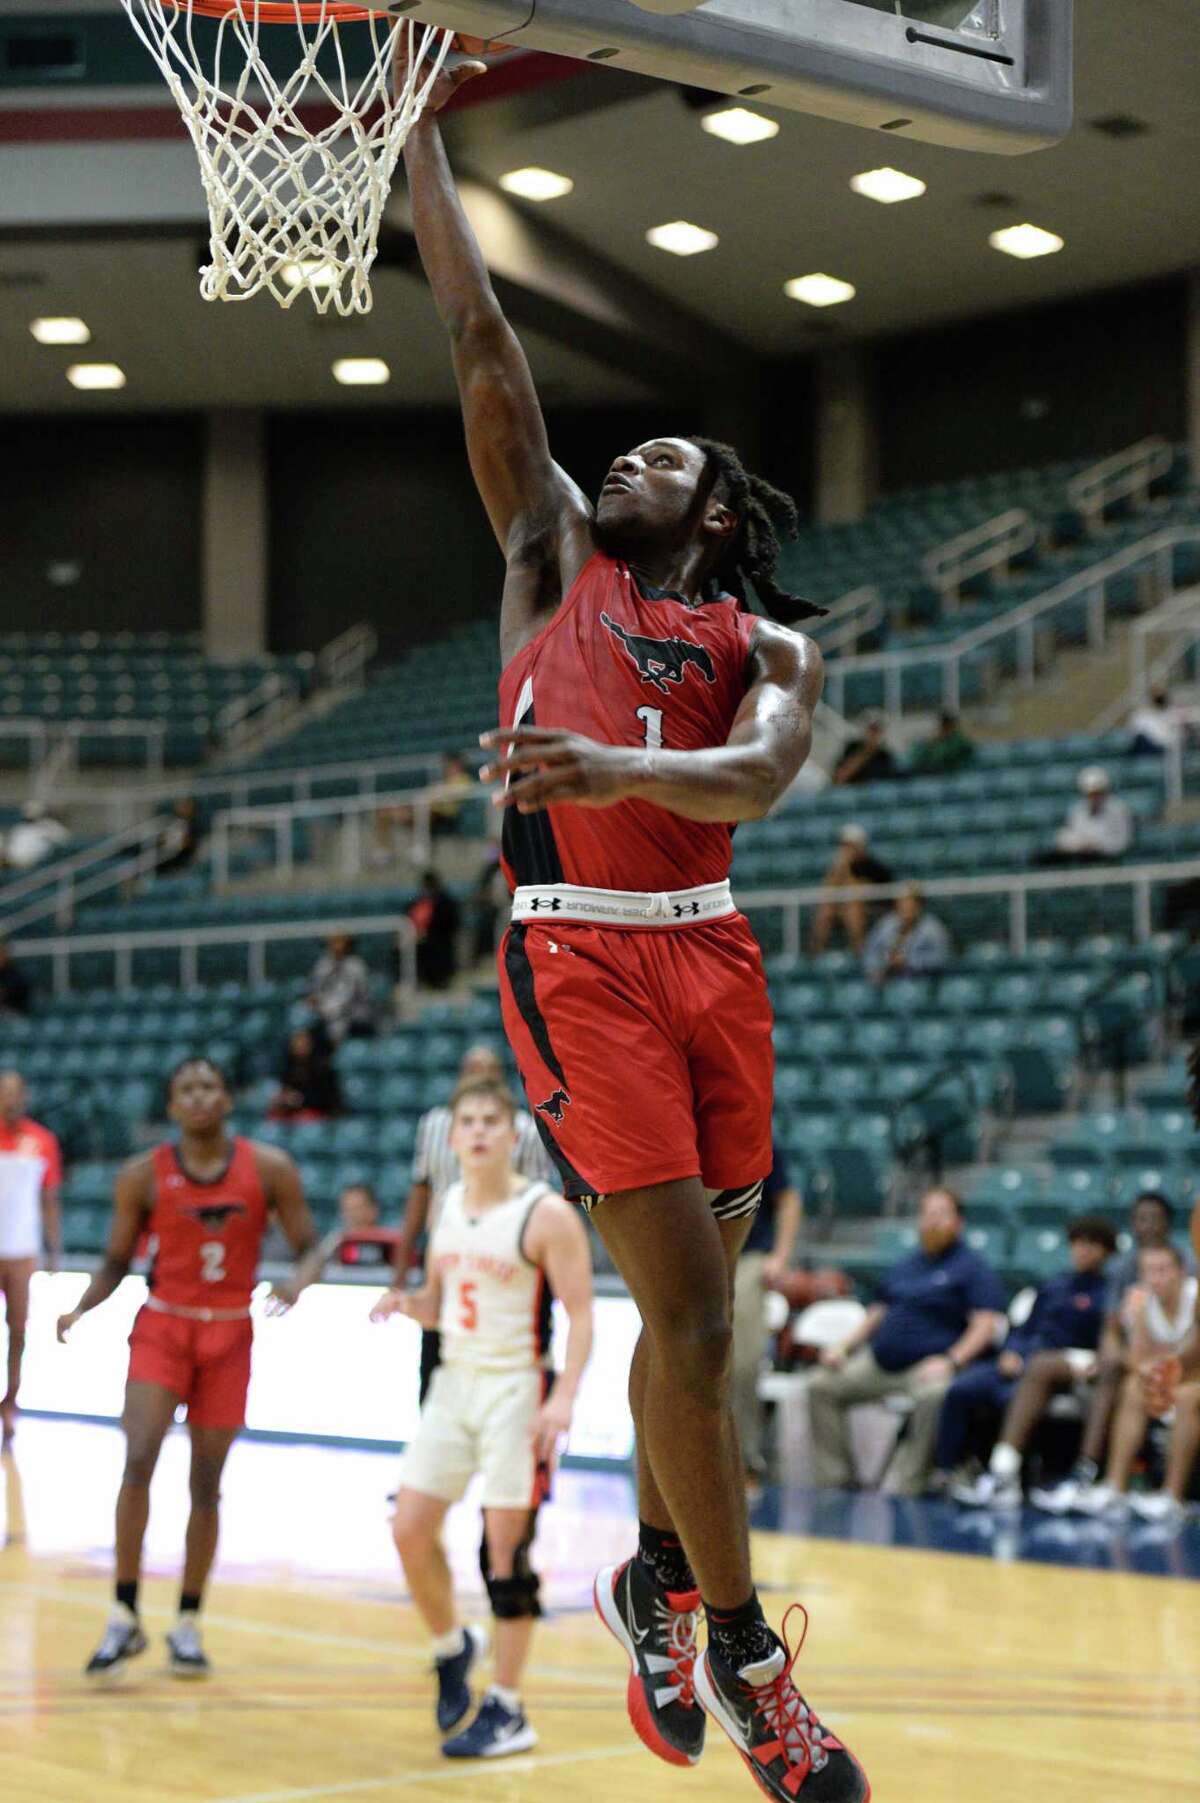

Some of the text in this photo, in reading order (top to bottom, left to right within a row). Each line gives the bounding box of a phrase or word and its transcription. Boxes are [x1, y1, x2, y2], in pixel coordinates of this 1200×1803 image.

[636, 705, 663, 750] 1
[200, 1242, 226, 1282] 2
[460, 1281, 477, 1331] 5
